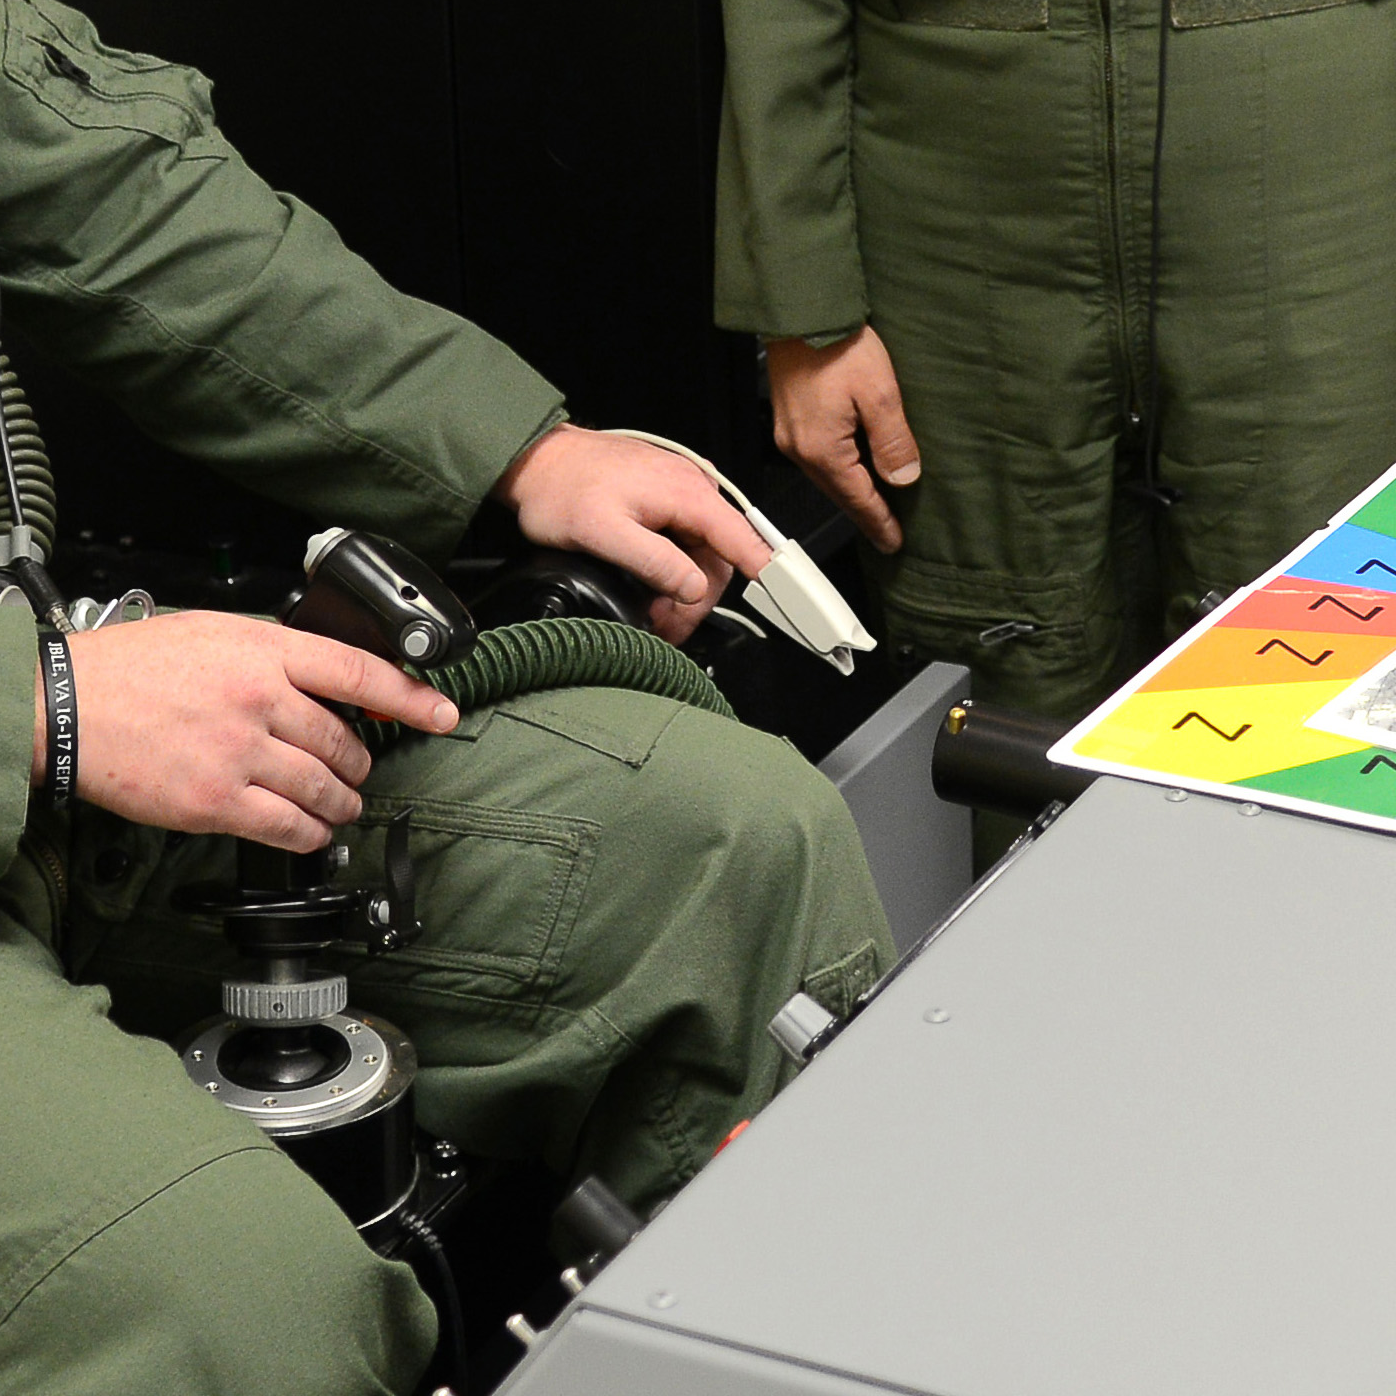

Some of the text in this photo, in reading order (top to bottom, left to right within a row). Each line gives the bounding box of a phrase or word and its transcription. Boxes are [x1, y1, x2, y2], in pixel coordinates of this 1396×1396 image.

[47, 641, 69, 678] JBLE,
[54, 678, 71, 704] VA
[56, 707, 73, 751] 16-17
